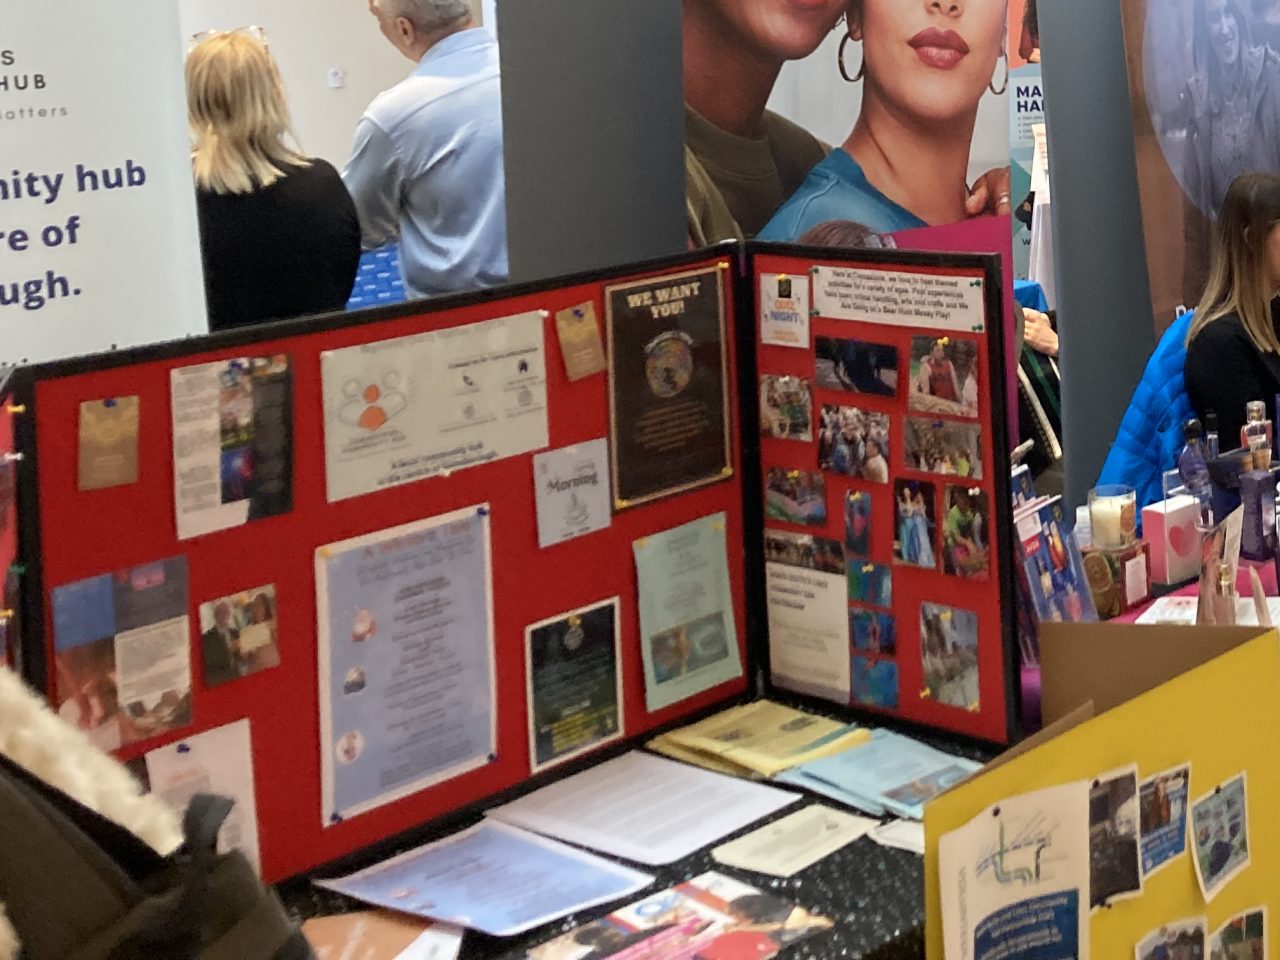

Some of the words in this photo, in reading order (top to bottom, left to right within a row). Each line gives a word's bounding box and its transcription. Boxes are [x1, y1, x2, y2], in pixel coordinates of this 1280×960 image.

[0, 105, 68, 121] atters
[75, 159, 147, 193] hub
[41, 215, 80, 248] of
[0, 270, 82, 311] ugh.
[626, 291, 652, 309] WE
[655, 282, 700, 305] WANT
[651, 300, 685, 319] YOU!
[770, 310, 800, 323] NIGHT
